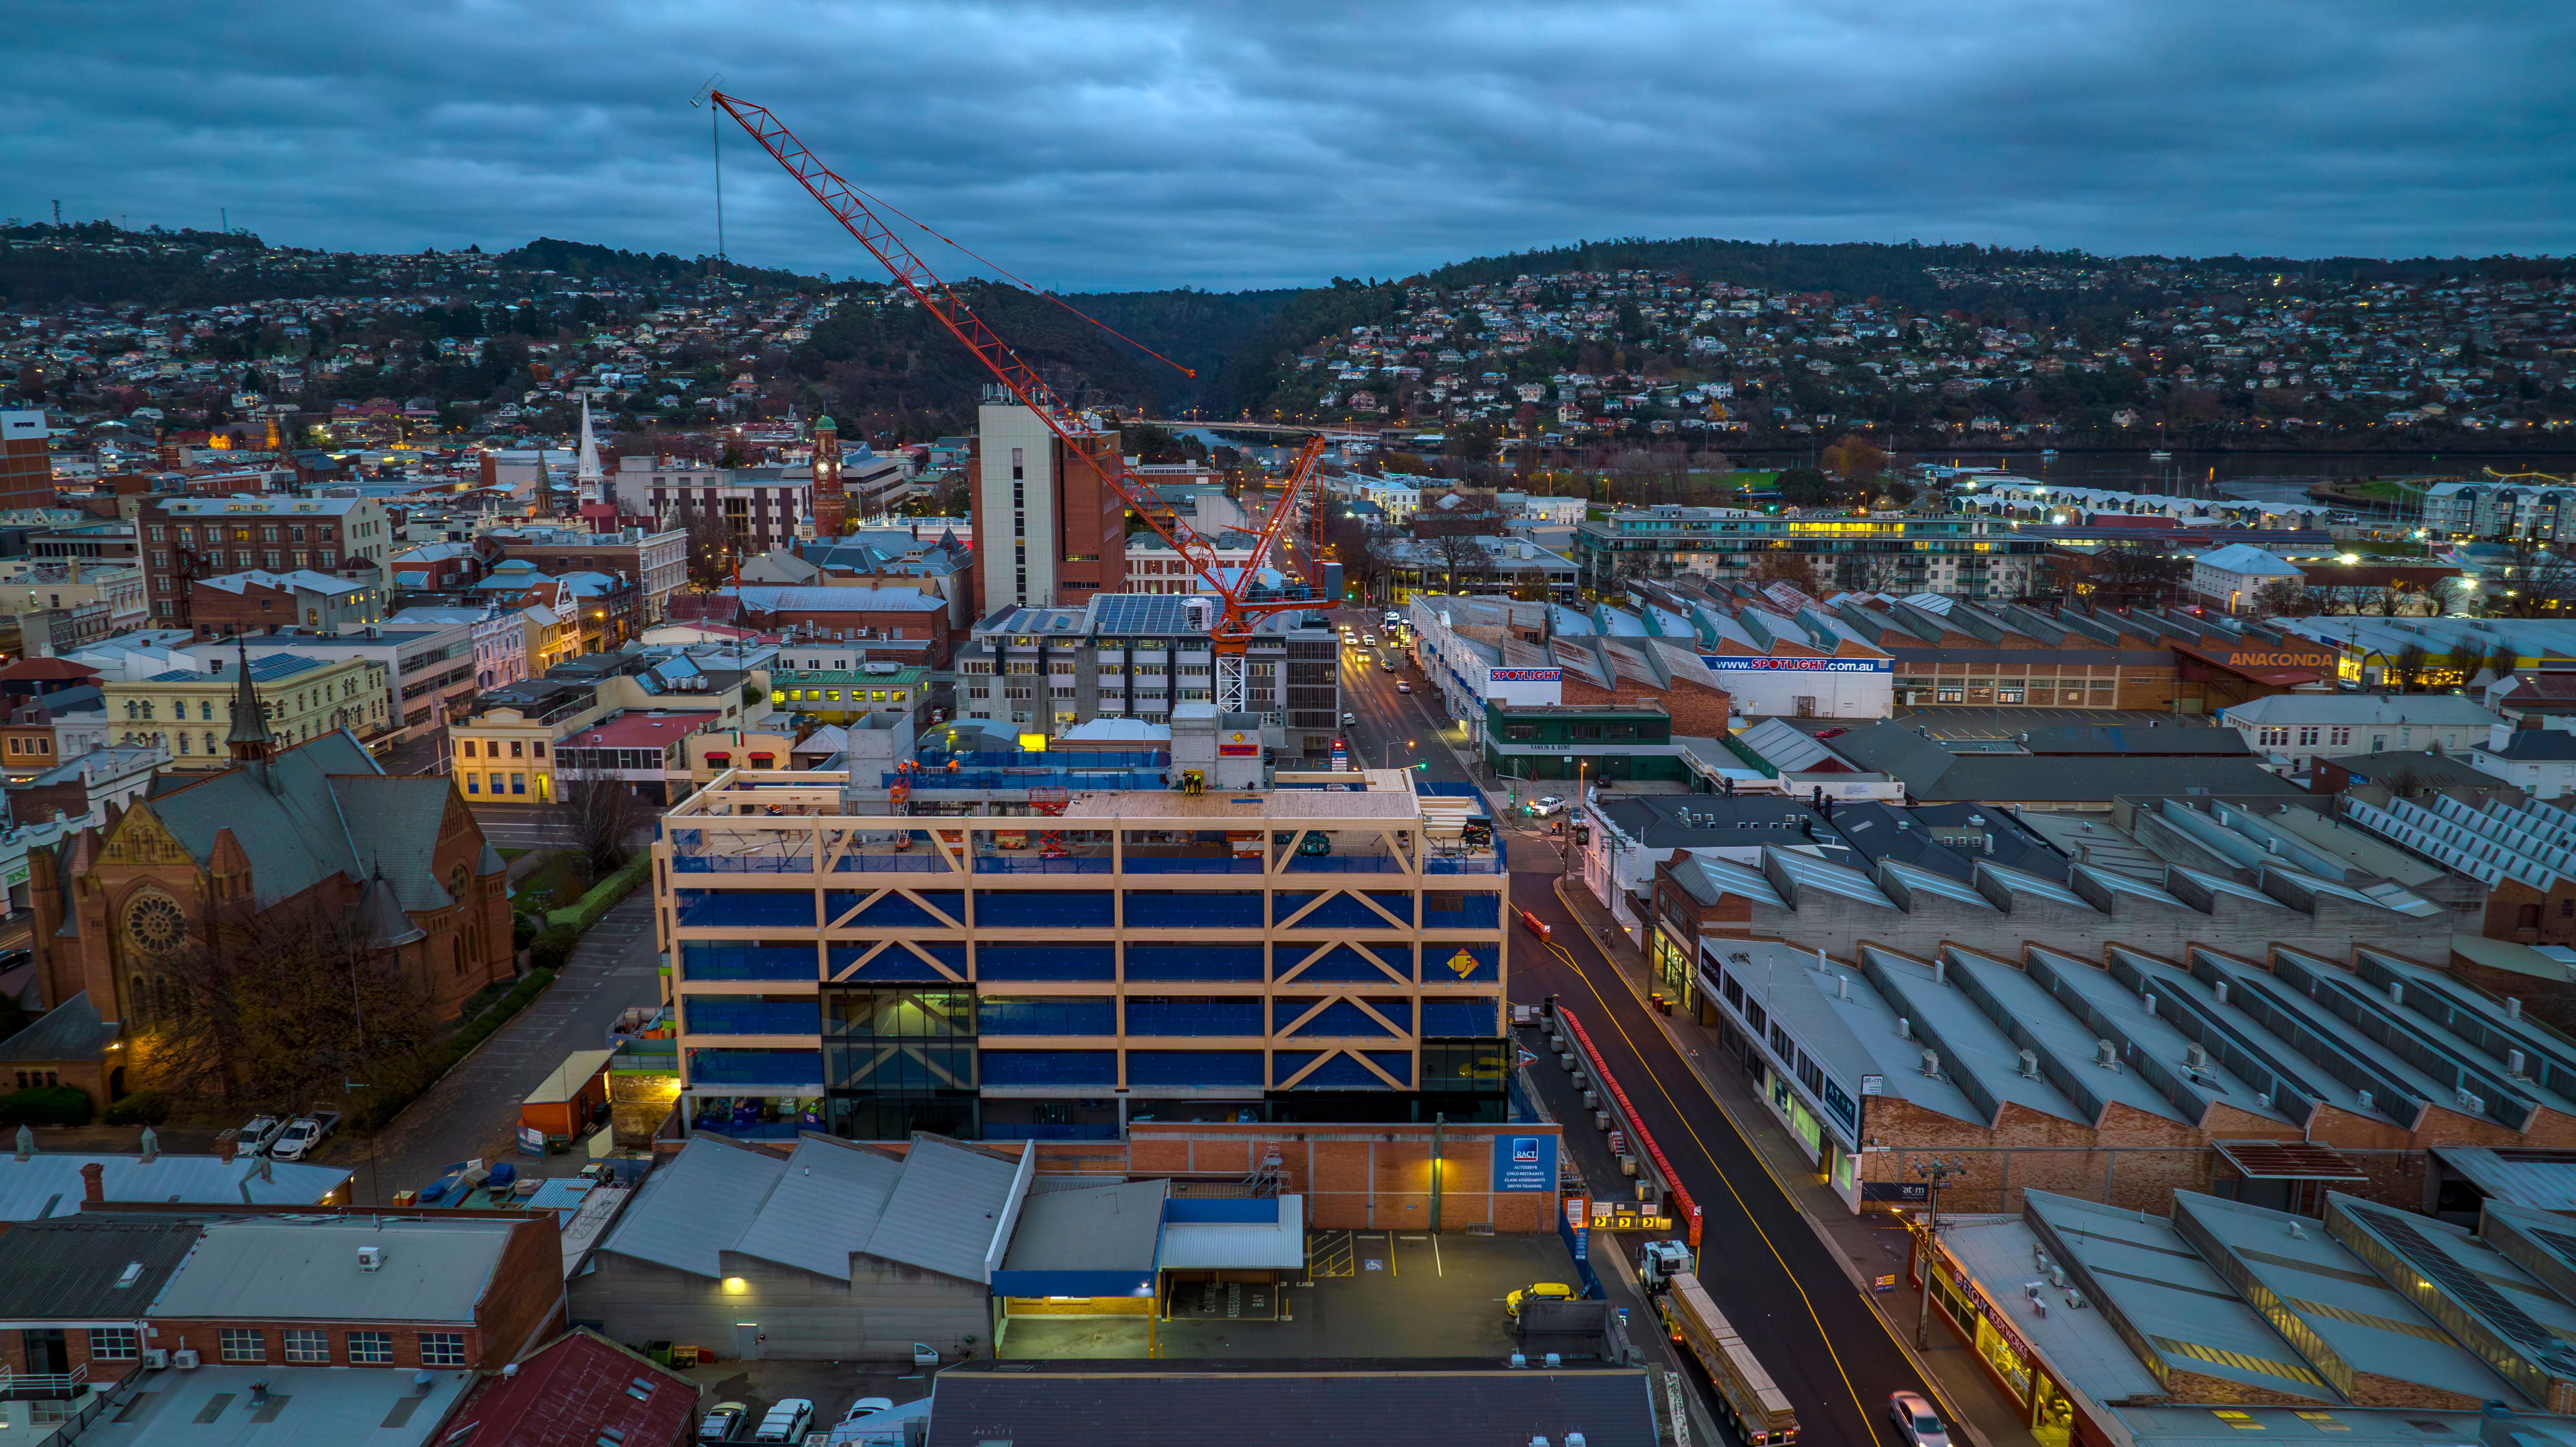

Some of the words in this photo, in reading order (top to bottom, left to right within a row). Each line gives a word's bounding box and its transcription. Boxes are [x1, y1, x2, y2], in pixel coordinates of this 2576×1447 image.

[1716, 659, 1874, 671] www.SPOTLIGHT.com.au
[2229, 652, 2334, 667] ANACONDA
[1492, 670, 1560, 680] SPOTLIGHT
[1252, 1294, 1264, 1307] BAY
[1990, 1308, 2028, 1358] BODYWORKS
